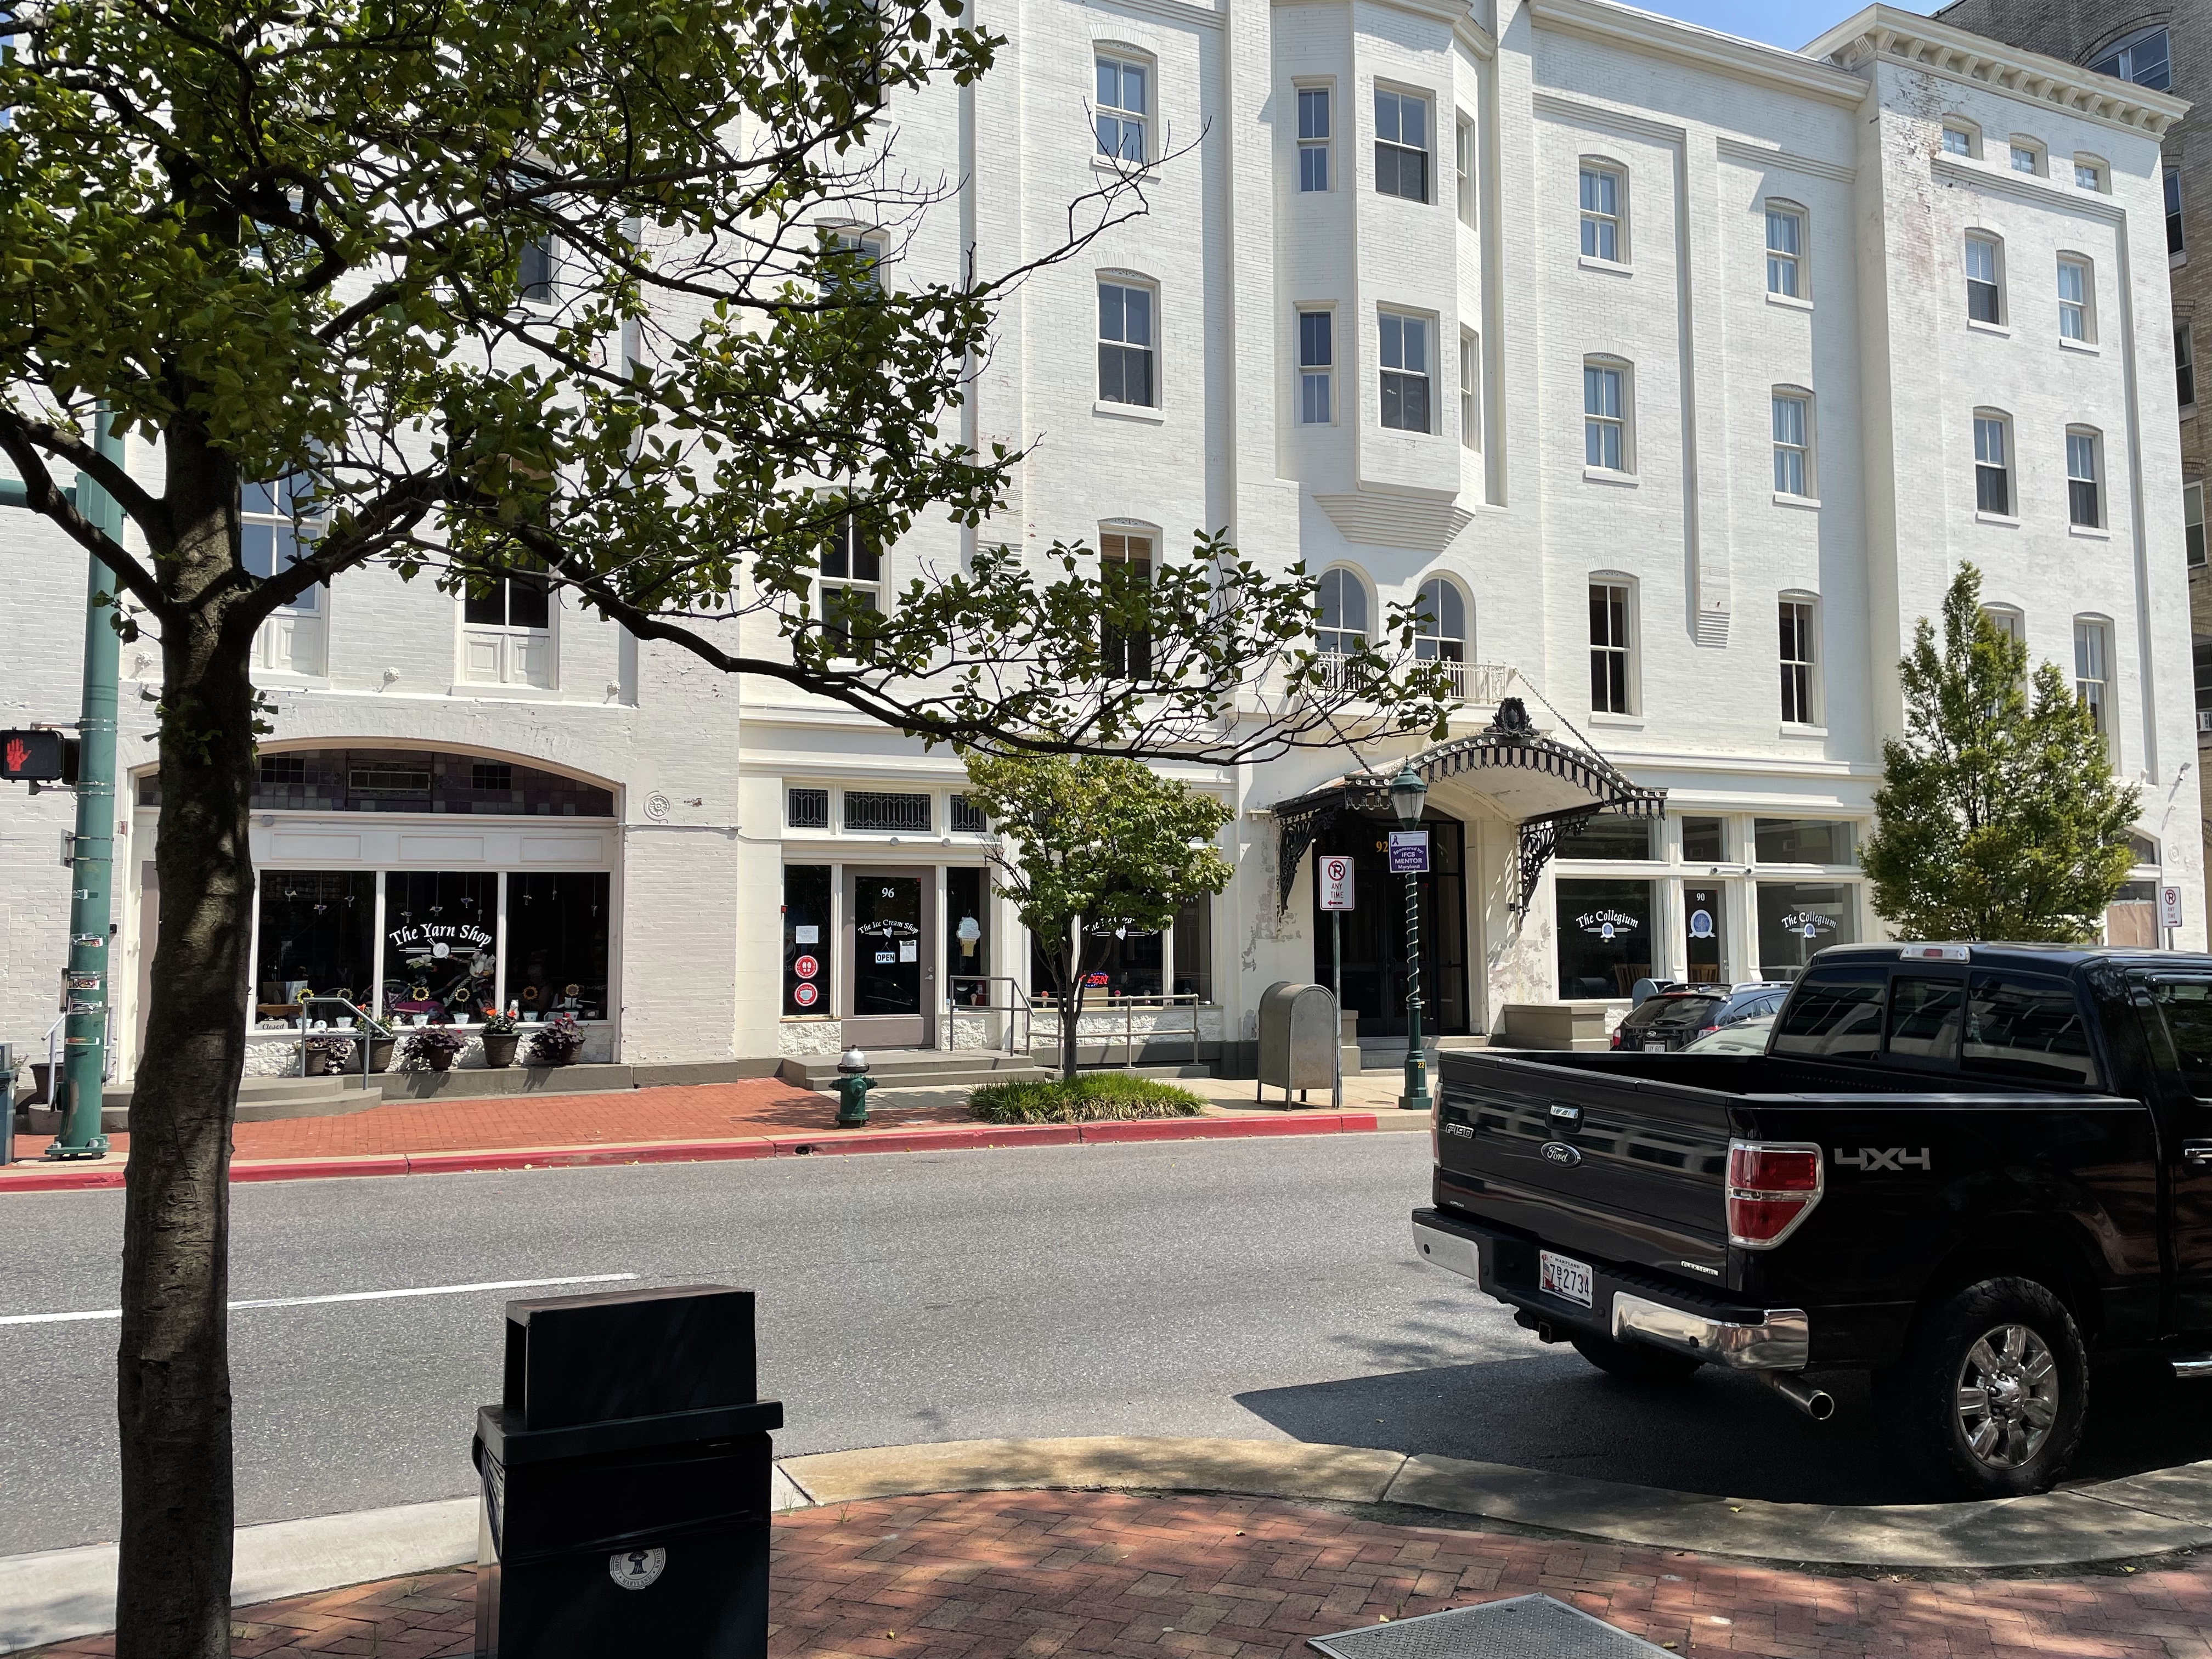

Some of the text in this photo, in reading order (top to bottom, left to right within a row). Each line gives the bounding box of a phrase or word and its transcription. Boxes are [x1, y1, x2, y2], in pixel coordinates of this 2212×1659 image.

[1376, 841, 1389, 853] 92
[1393, 847, 1417, 855] Sponsored
[882, 887, 895, 898] 96
[1696, 893, 1705, 901] 90
[1576, 909, 1639, 928] The Collegium
[1781, 911, 1837, 929] The Collegium
[857, 923, 872, 934] The
[883, 919, 903, 928] Cream
[904, 922, 919, 935] Shop
[389, 923, 493, 947] The Yarn Shop
[877, 953, 895, 962] OPEN
[1547, 1146, 1568, 1163] Ford
[1555, 1257, 1580, 1269] MARYLAND
[622, 1575, 652, 1587] MARYLAND
